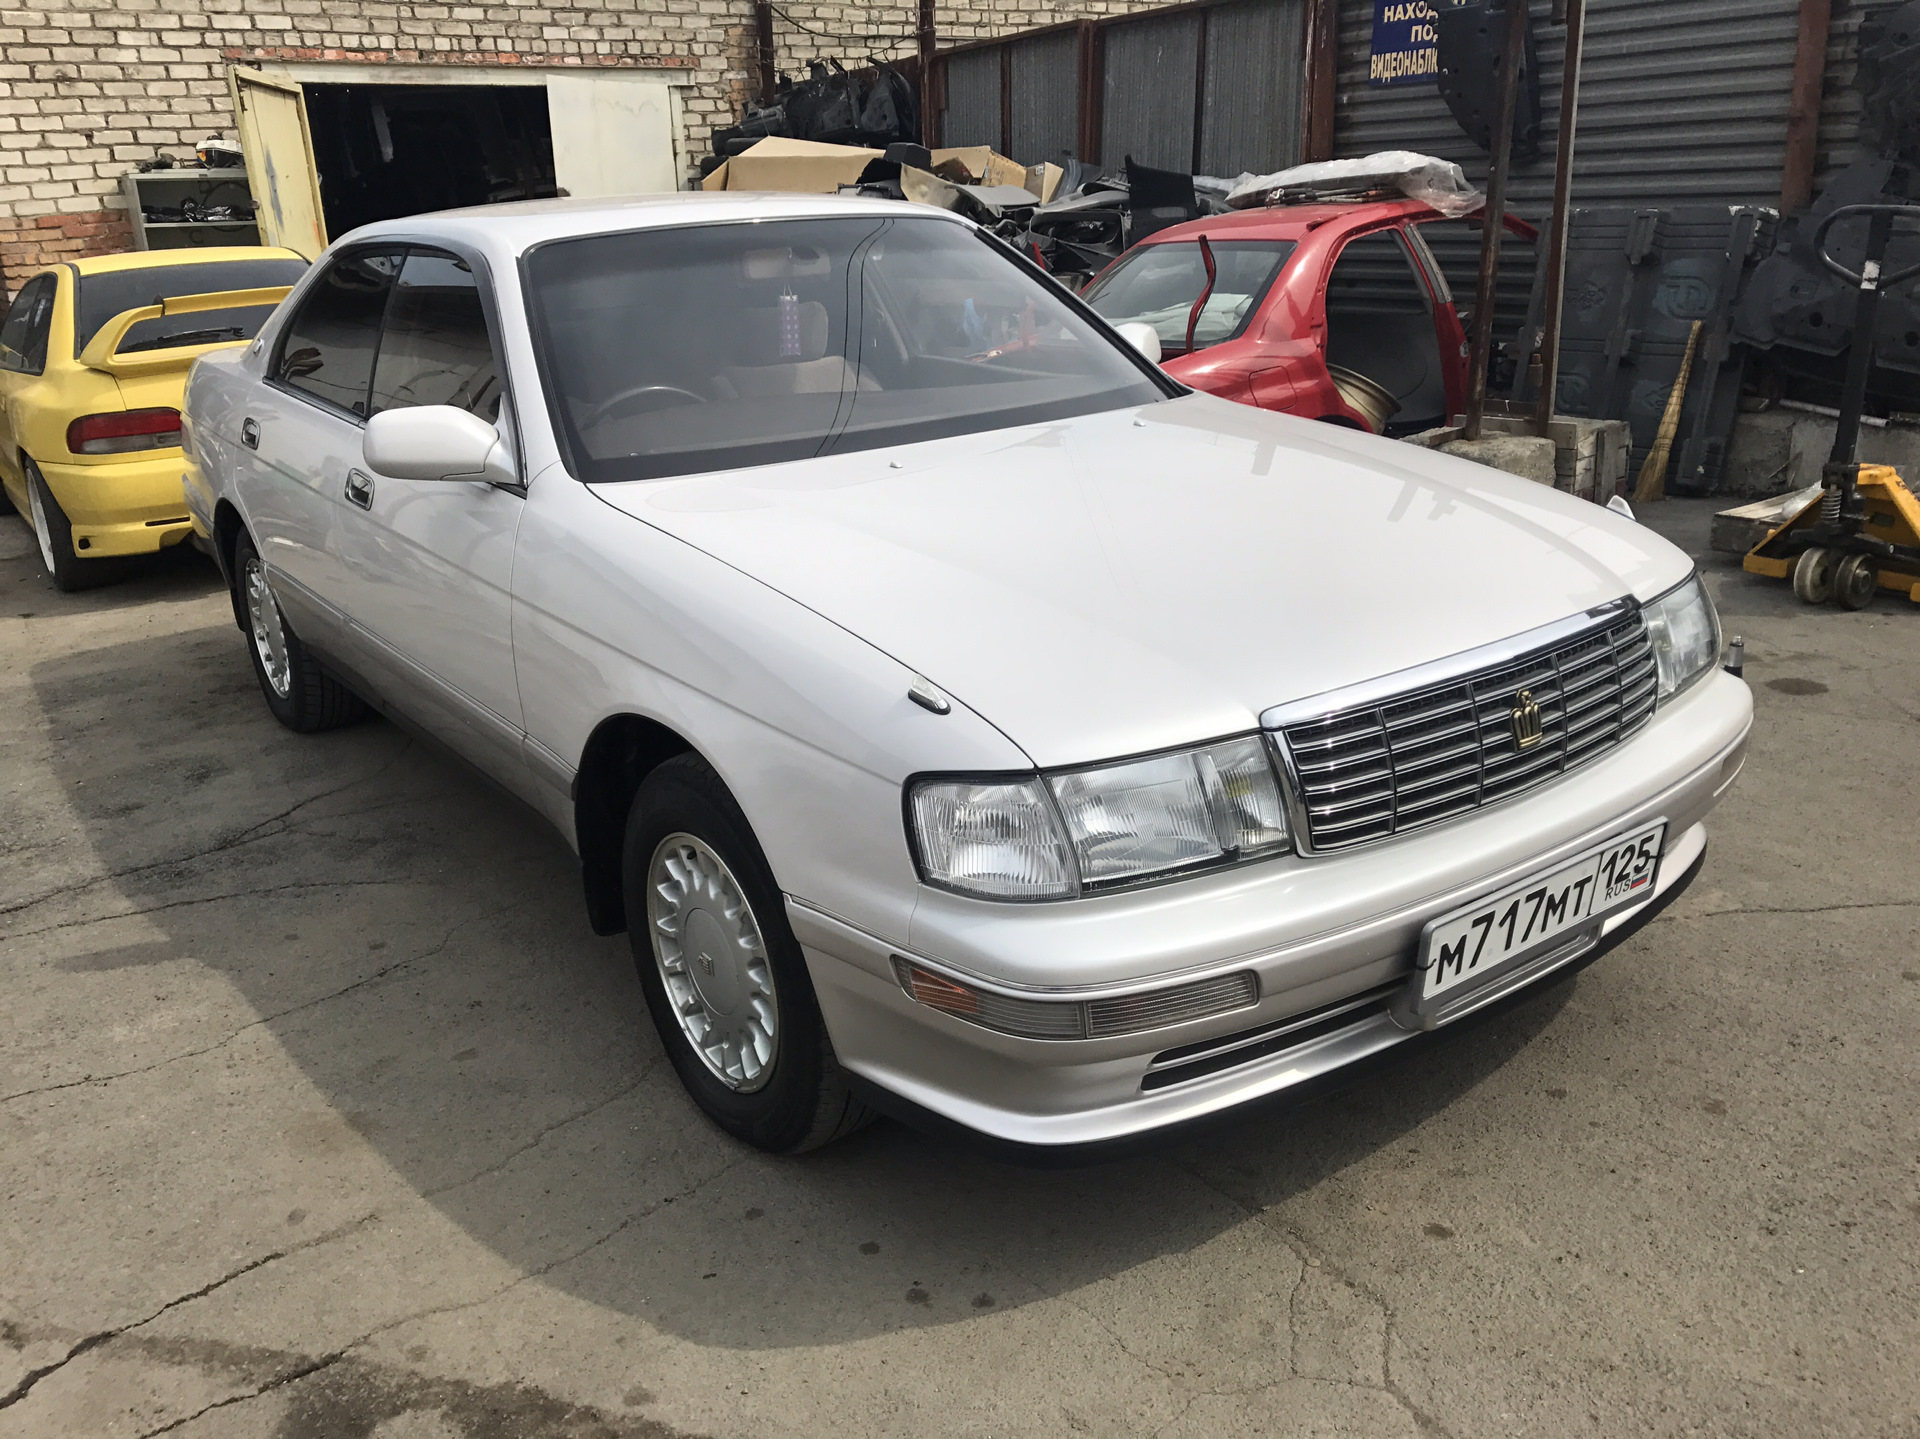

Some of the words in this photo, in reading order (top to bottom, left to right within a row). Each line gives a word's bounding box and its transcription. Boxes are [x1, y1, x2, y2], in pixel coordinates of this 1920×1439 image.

[1410, 23, 1438, 43] ПО
[1602, 833, 1655, 889] 125
[1604, 878, 1631, 902] RUS
